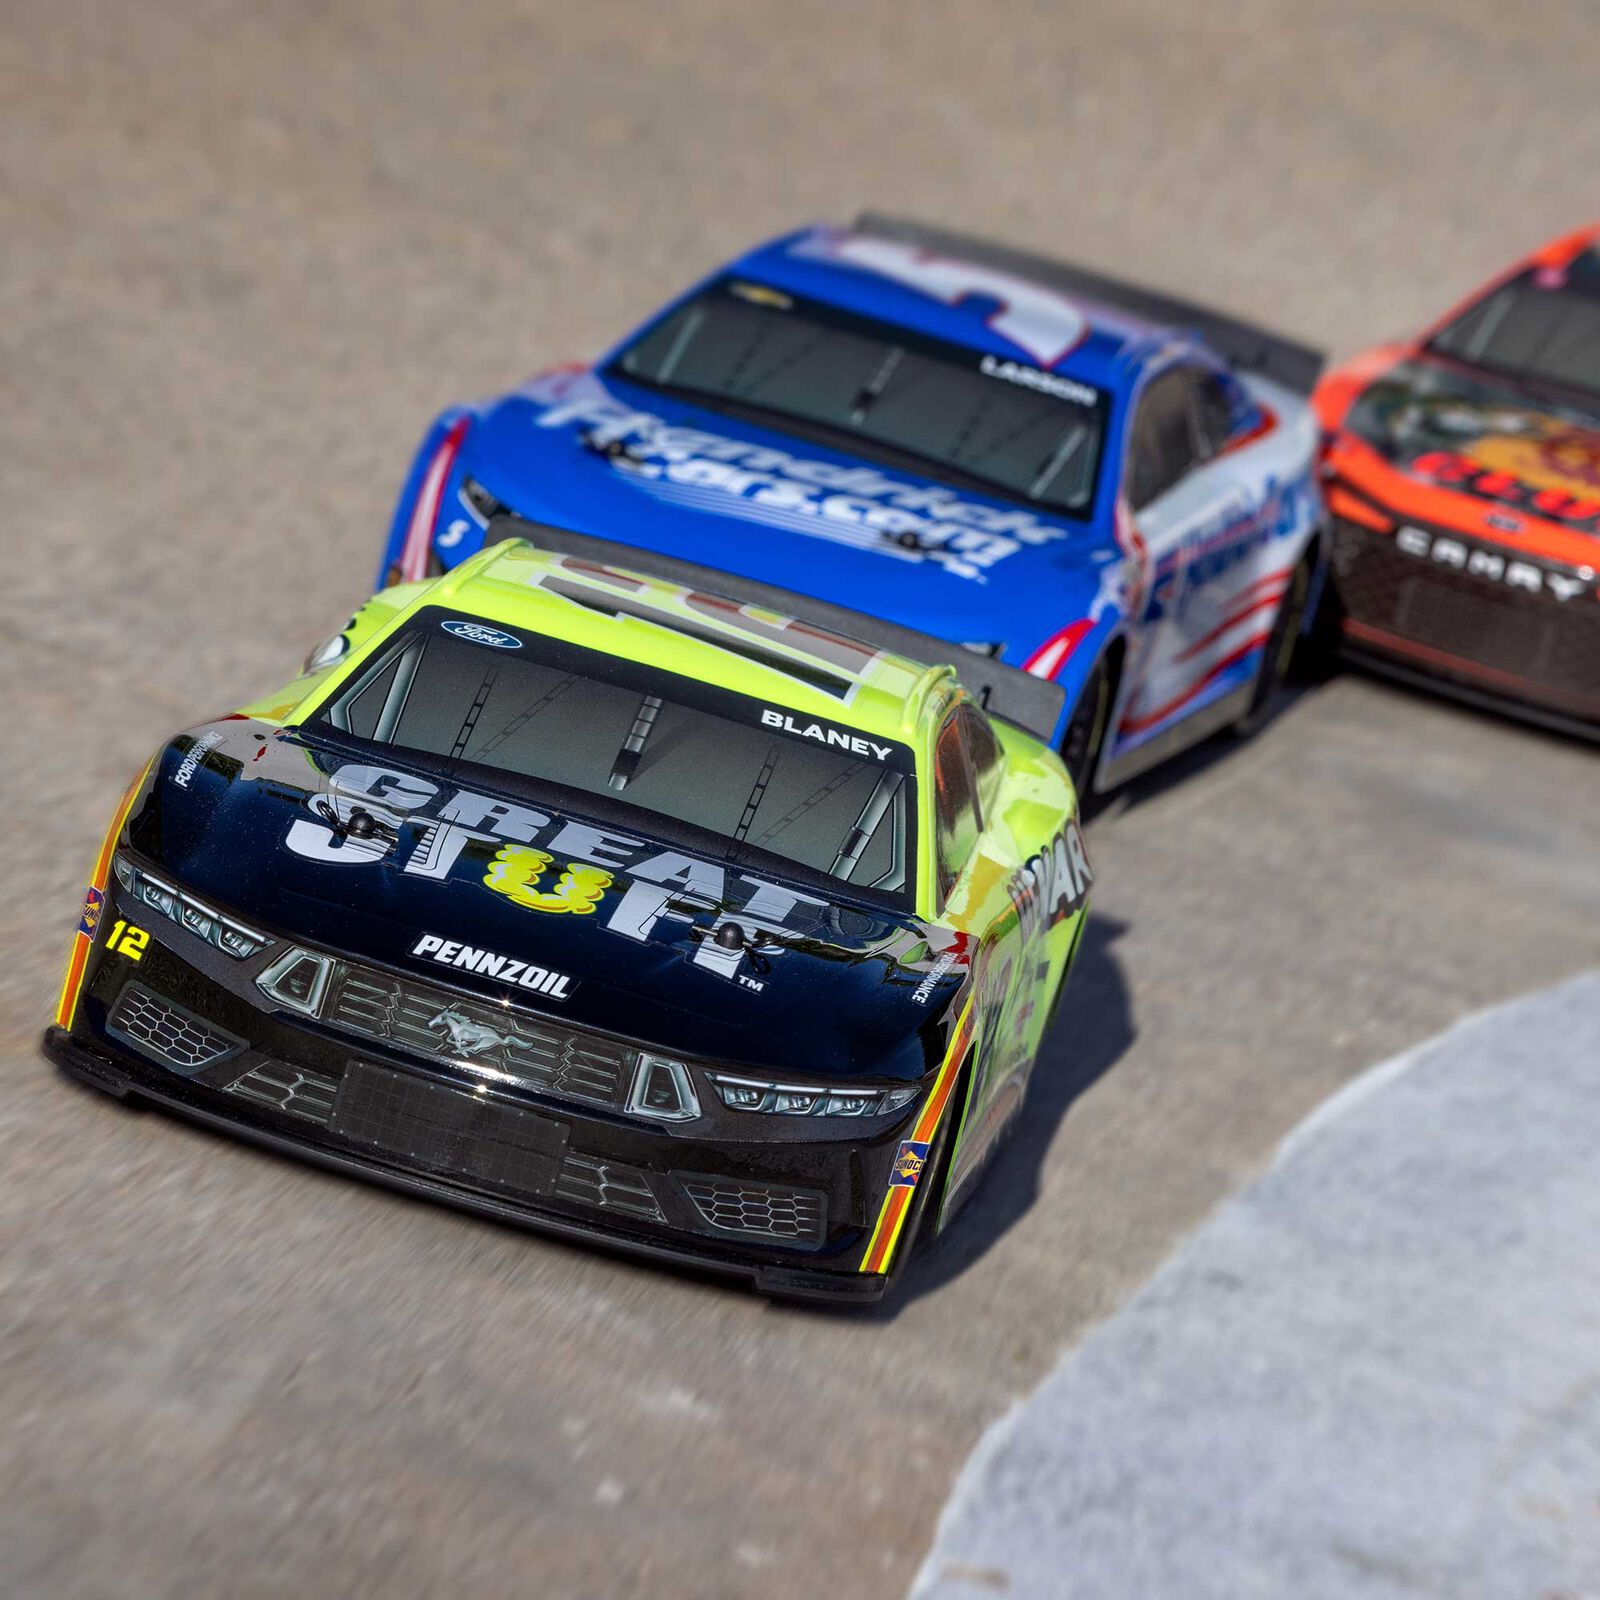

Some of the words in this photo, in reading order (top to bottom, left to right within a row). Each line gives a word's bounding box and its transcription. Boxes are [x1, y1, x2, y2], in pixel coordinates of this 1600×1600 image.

[980, 354, 1098, 407] LARSON
[1396, 525, 1586, 602] CAMRY
[453, 623, 509, 645] Ford
[761, 709, 893, 761] BLANEY
[329, 764, 830, 923] GREAT
[105, 920, 150, 961] 12
[412, 934, 570, 998] PENNZOIL
